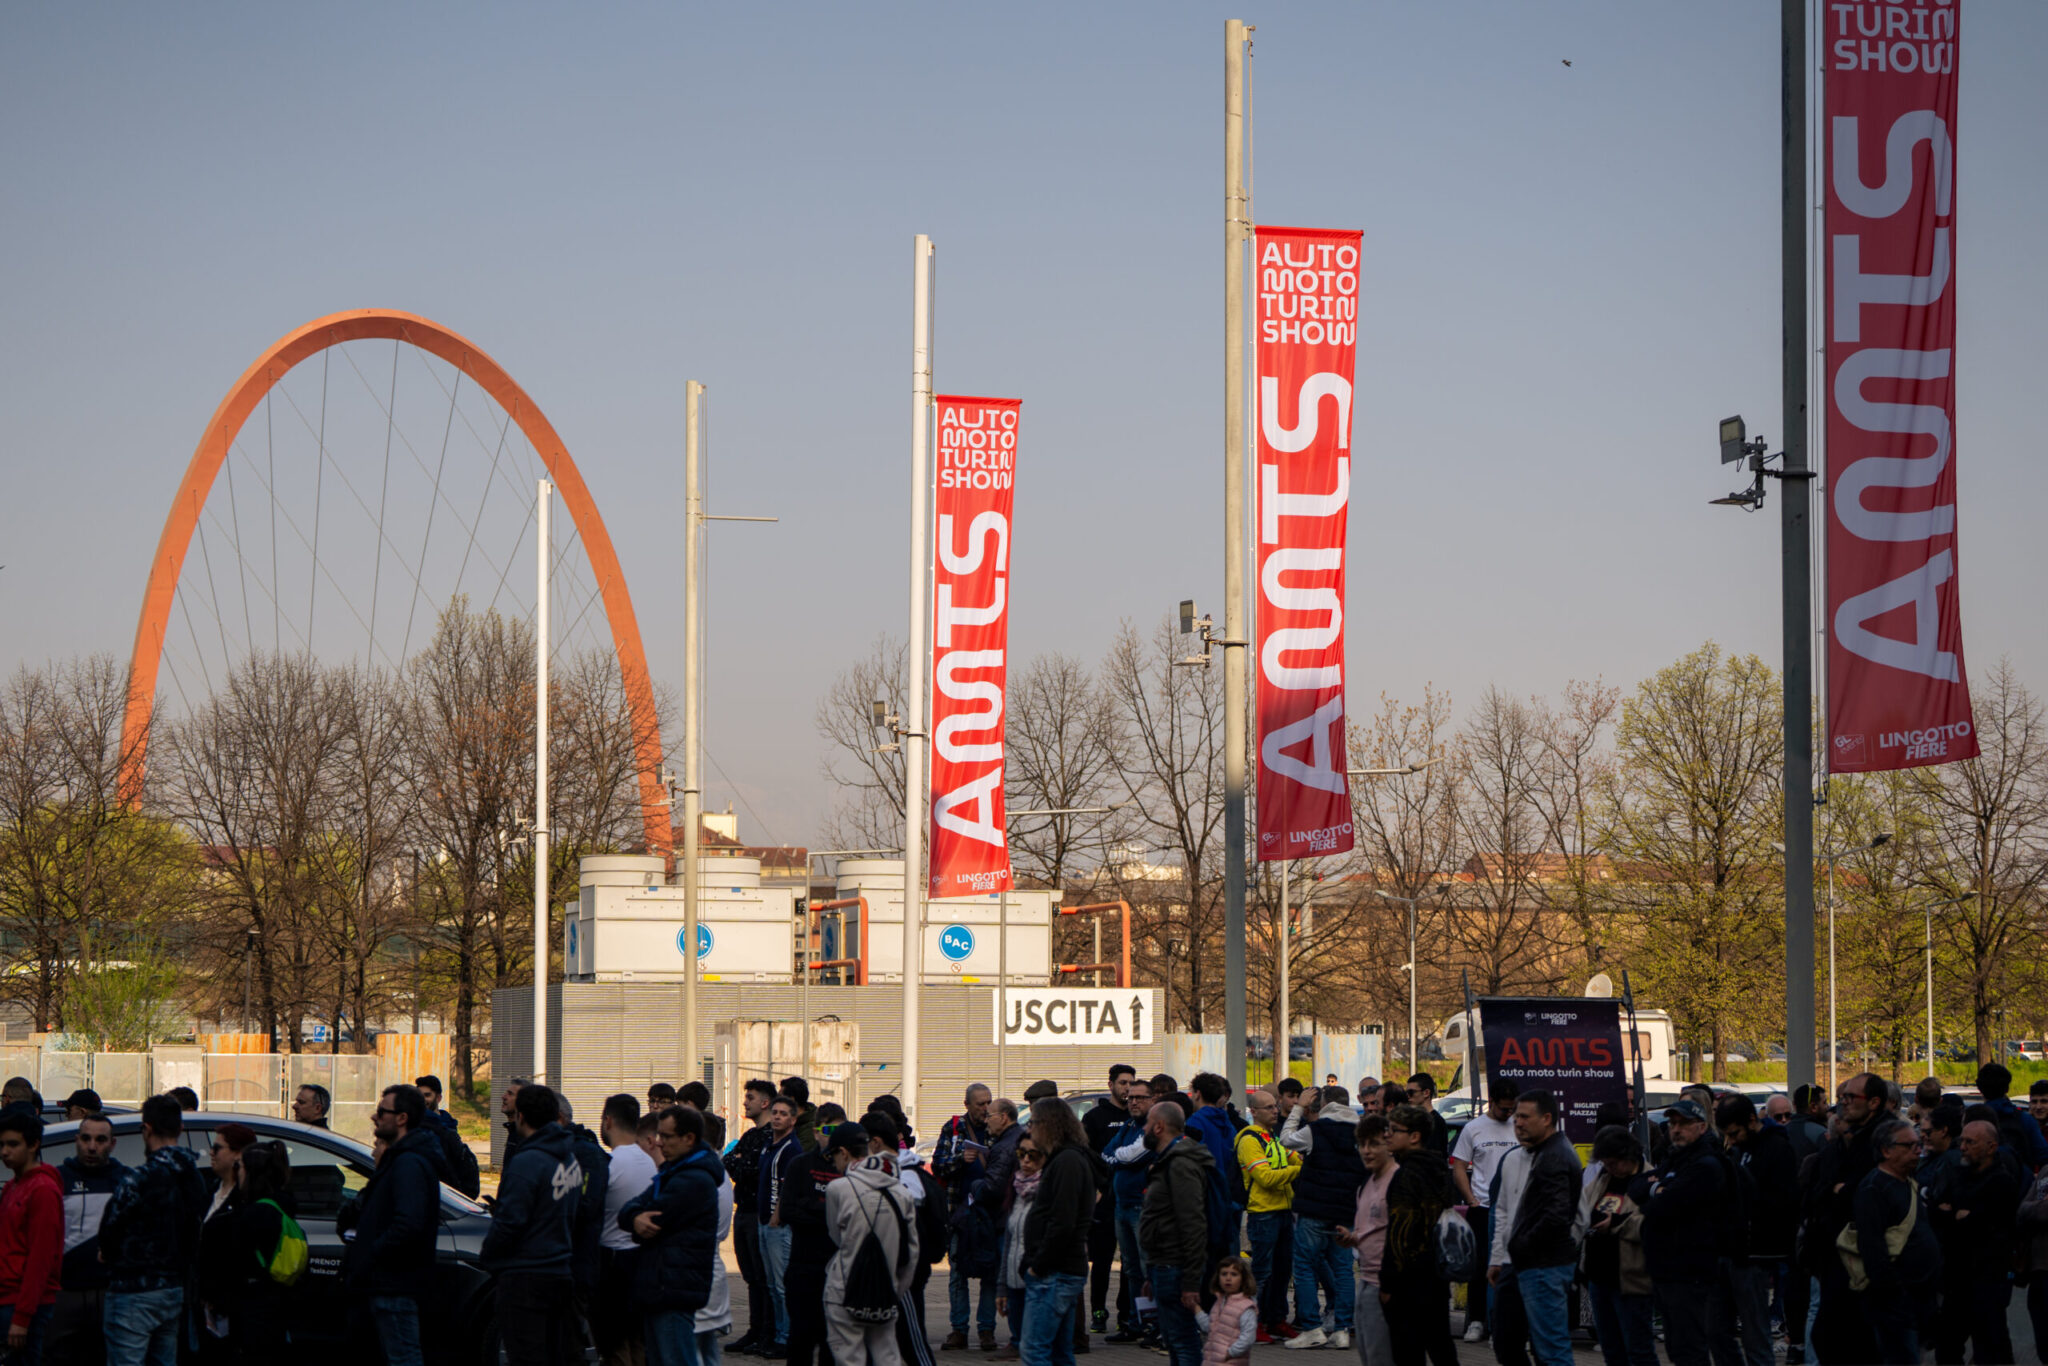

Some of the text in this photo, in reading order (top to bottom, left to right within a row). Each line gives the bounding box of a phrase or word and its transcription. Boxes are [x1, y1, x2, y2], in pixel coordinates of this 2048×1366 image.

[1831, 4, 1955, 40] TURIN
[1834, 39, 1954, 74] SHOW
[1261, 241, 1358, 269] AUTO
[1263, 267, 1357, 295] MOTO
[1260, 293, 1356, 321] TURIN
[1262, 319, 1356, 346] SHOW
[1832, 109, 1960, 684] AMTS
[941, 407, 1018, 430] AUTO
[942, 427, 1015, 450] MOTO
[940, 448, 1013, 470] TURIN
[940, 468, 1012, 490] SHOW
[1261, 371, 1352, 795] AMTS
[934, 510, 1008, 848] AMTS
[1879, 720, 1971, 749] LINGOTTO
[1905, 740, 1948, 761] FIERE
[1289, 822, 1353, 844] LINGOTTO
[1308, 838, 1338, 853] FIERE
[956, 868, 1009, 884] LINGOTTO
[971, 880, 996, 892] FIERE
[944, 934, 970, 951] BAC
[1004, 998, 1122, 1035] USCITA
[1540, 1012, 1578, 1021] LINGOTTO
[1551, 1018, 1568, 1026] FIERE
[1499, 1037, 1612, 1066] AMTS
[1500, 1069, 1525, 1077] auto
[1557, 1068, 1582, 1077] turin
[1584, 1068, 1614, 1077] show
[309, 1258, 342, 1267] PRENOT
